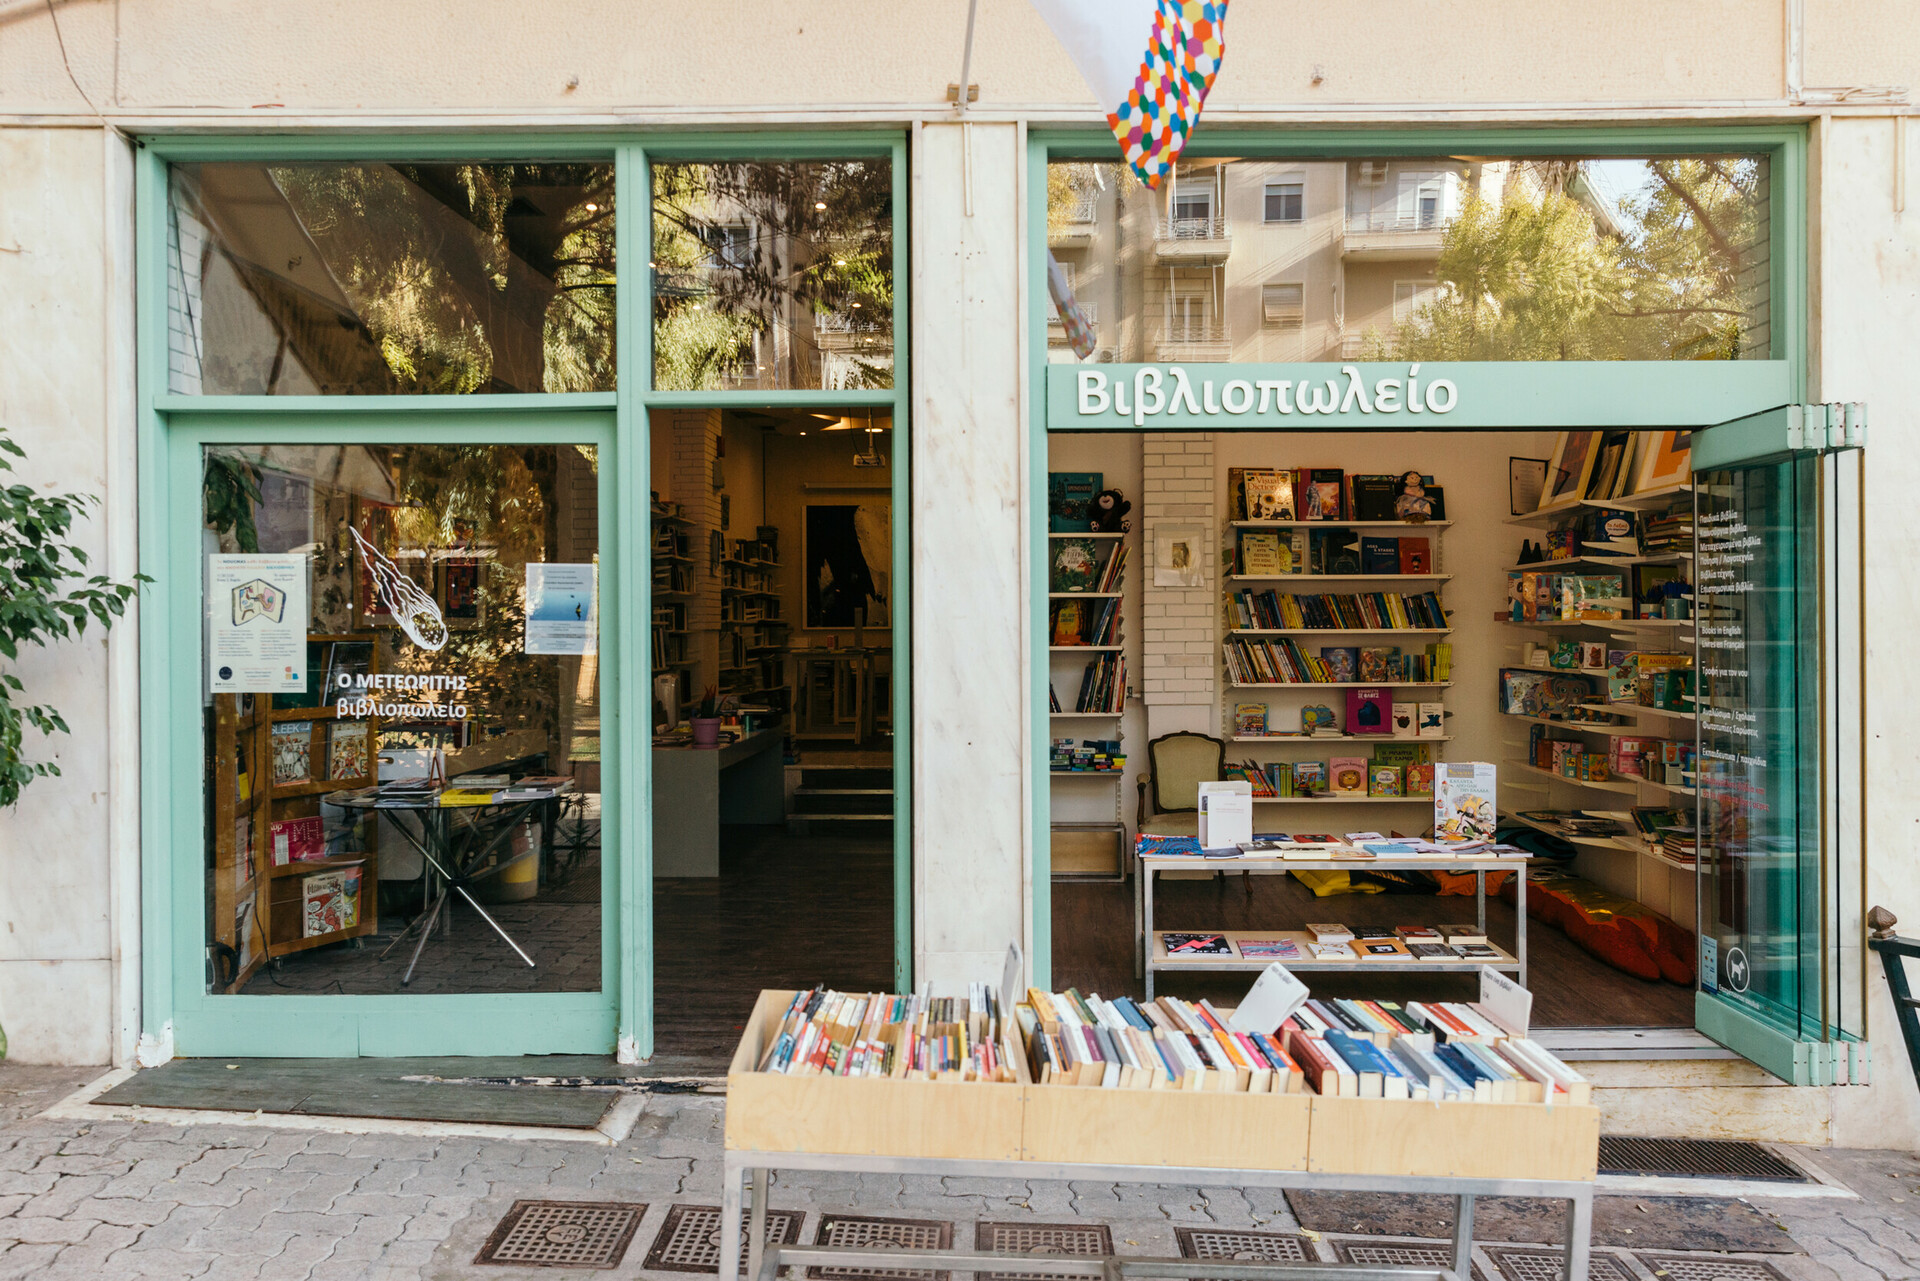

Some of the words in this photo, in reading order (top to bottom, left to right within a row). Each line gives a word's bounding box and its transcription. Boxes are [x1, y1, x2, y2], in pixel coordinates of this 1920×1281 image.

[1077, 363, 1459, 427] Βιβλιοπωλείο
[1700, 513, 1719, 524] Παιδικά
[1720, 509, 1738, 522] βιβλία
[1729, 522, 1747, 535] βιβλία
[1700, 539, 1742, 551] Μεταχειρισμένα
[1743, 536, 1761, 549] βιβλία
[1723, 551, 1754, 564] Λογοτεχνία
[1700, 570, 1716, 580] Βιβλία
[1717, 569, 1735, 579] τέχνης
[1735, 581, 1754, 593] βιβλία
[1702, 626, 1717, 635] Books
[1717, 626, 1722, 635] in
[1722, 626, 1741, 637] English
[1701, 640, 1716, 648] Livres
[1723, 640, 1745, 651] Français
[1702, 666, 1718, 677] Τροφή
[1719, 669, 1728, 678] για
[1728, 669, 1737, 677] τον
[1738, 670, 1748, 678] νου
[338, 673, 352, 688] Ο
[356, 673, 468, 691] ΜΕΤΕΩΡΙΤΗΣ
[336, 697, 467, 720] βιβλιοπωλείο
[1735, 711, 1756, 722] Σχολικά
